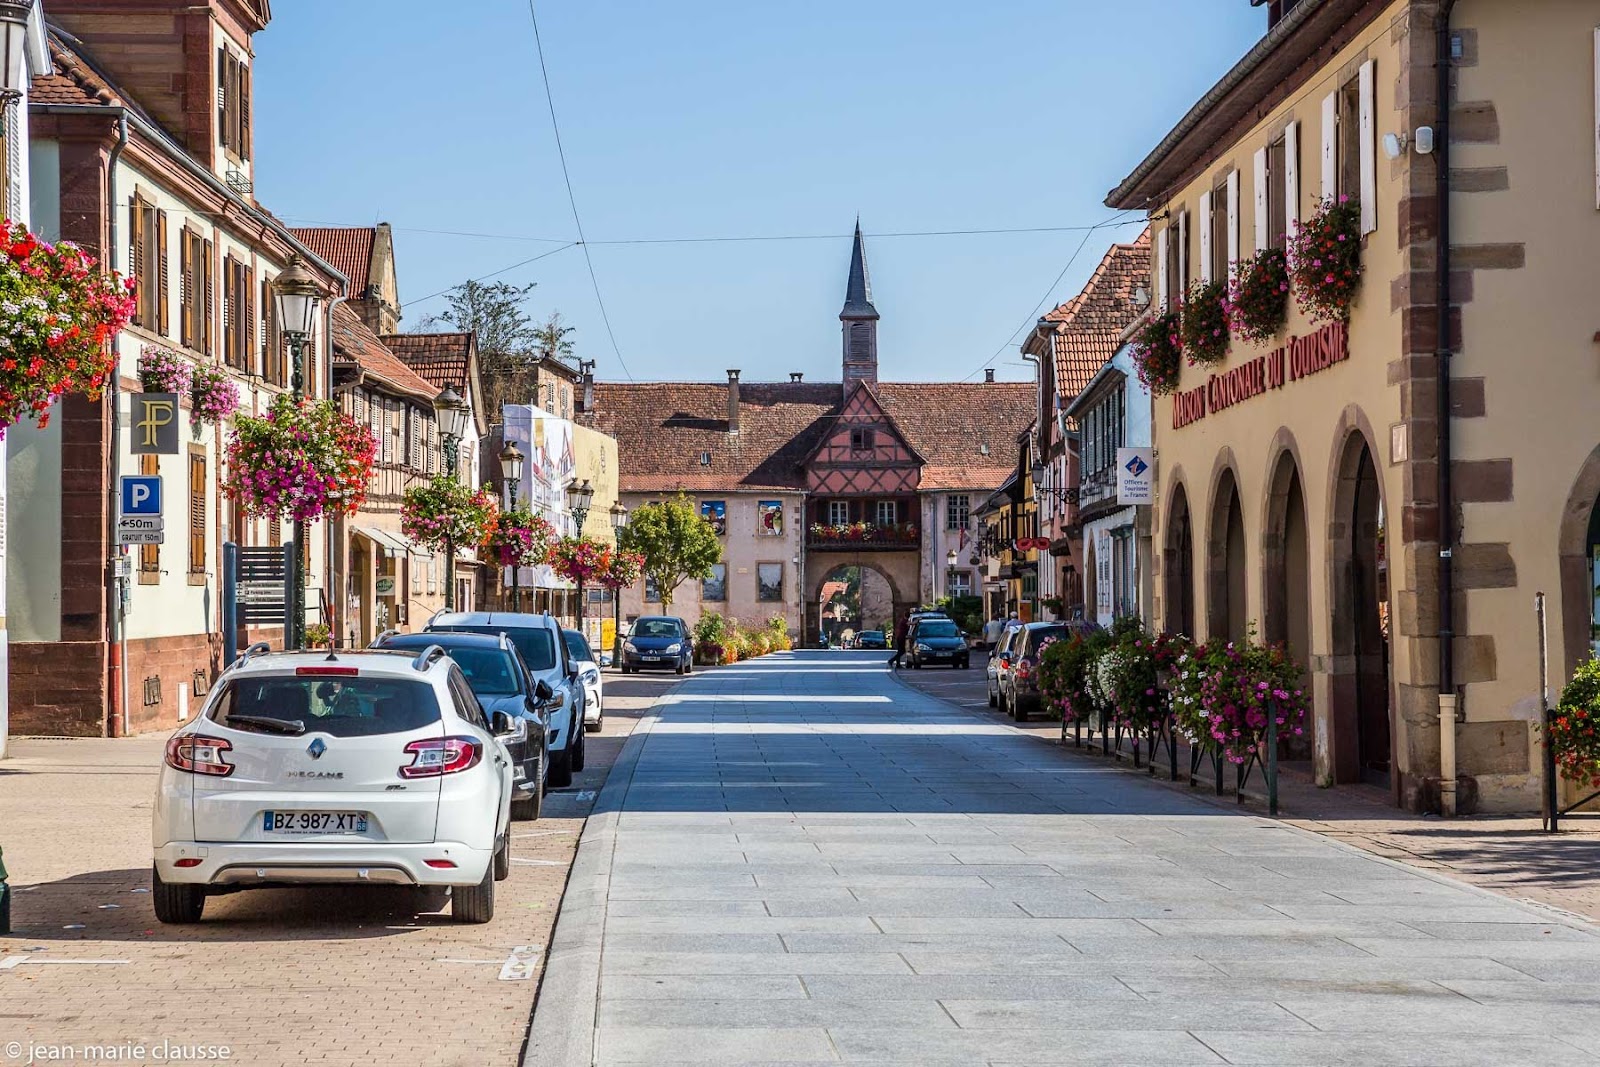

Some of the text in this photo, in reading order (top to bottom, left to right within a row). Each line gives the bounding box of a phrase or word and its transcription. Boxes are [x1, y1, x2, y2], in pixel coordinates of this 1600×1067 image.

[1172, 320, 1349, 430] MAISON CANTONALE DU TOURISME
[131, 484, 150, 508] P
[129, 519, 153, 528] 50m
[287, 771, 344, 779] MEGANE
[274, 813, 357, 829] BZ-987-XT
